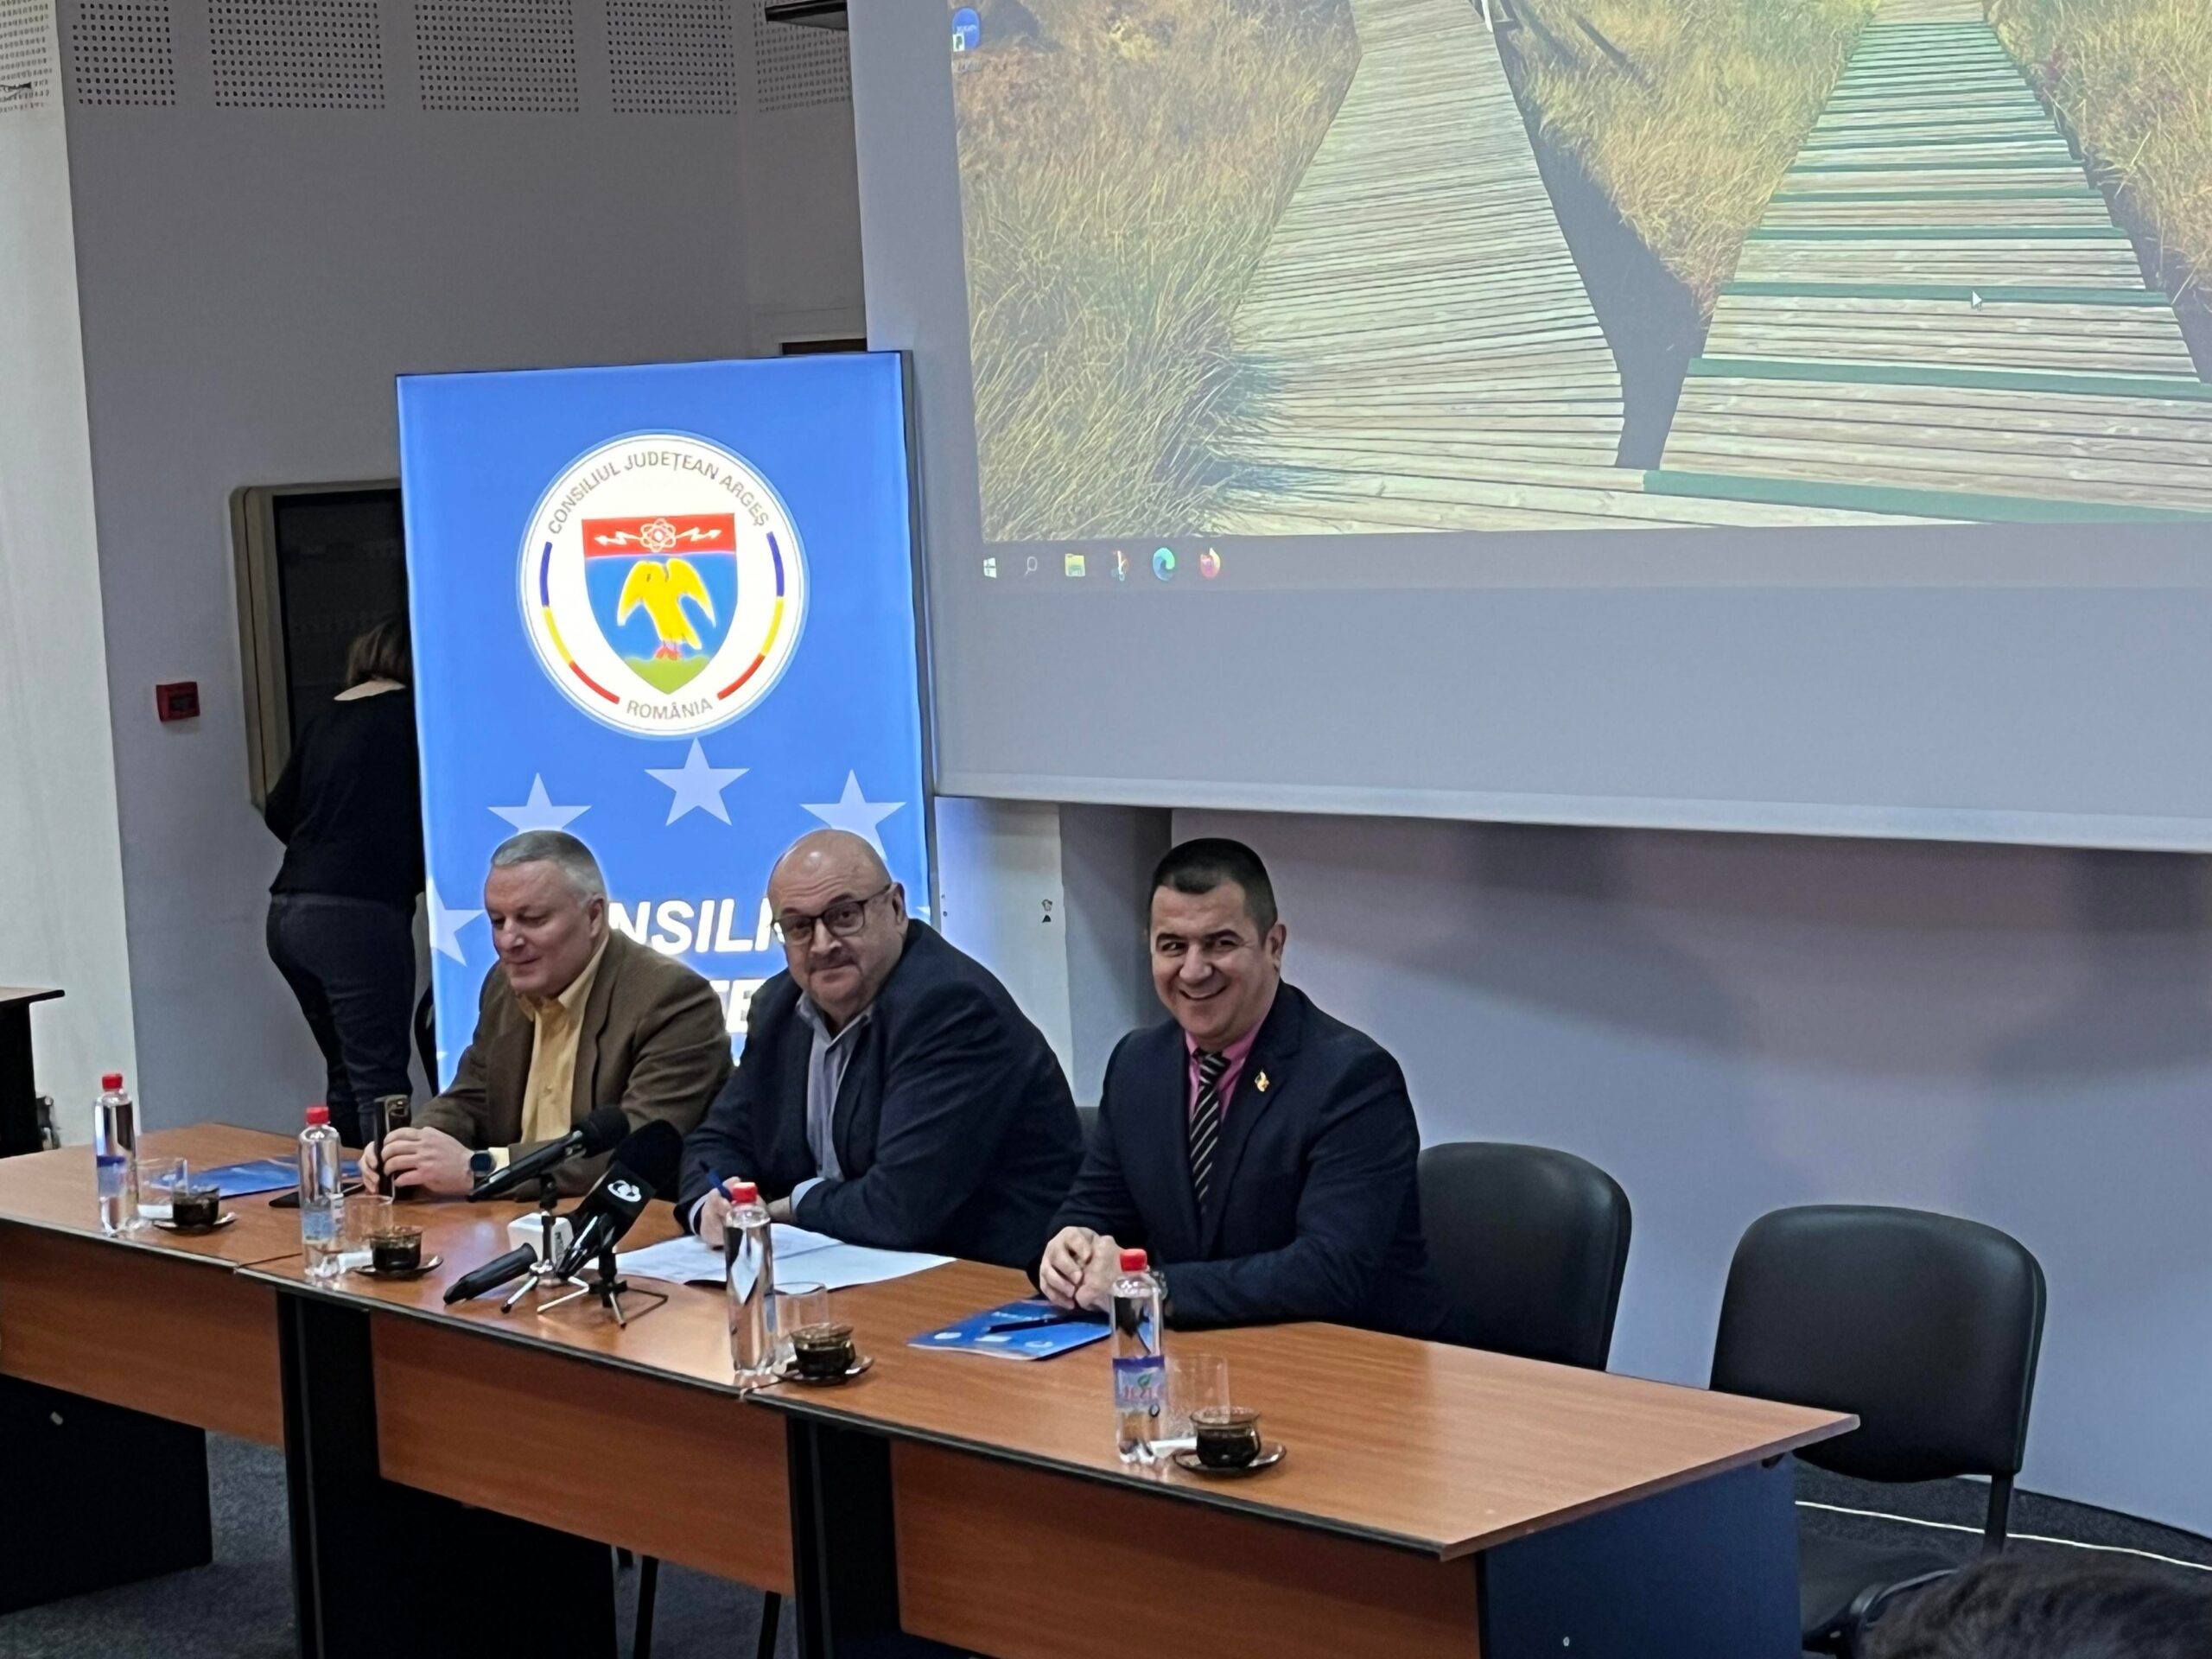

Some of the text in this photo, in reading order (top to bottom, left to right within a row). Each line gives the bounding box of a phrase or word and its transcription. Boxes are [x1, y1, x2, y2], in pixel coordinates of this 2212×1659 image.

[548, 451, 769, 535] CONSILIUL JUDEȚEAN ARGEȘ
[626, 697, 713, 720] ROMÂNIA
